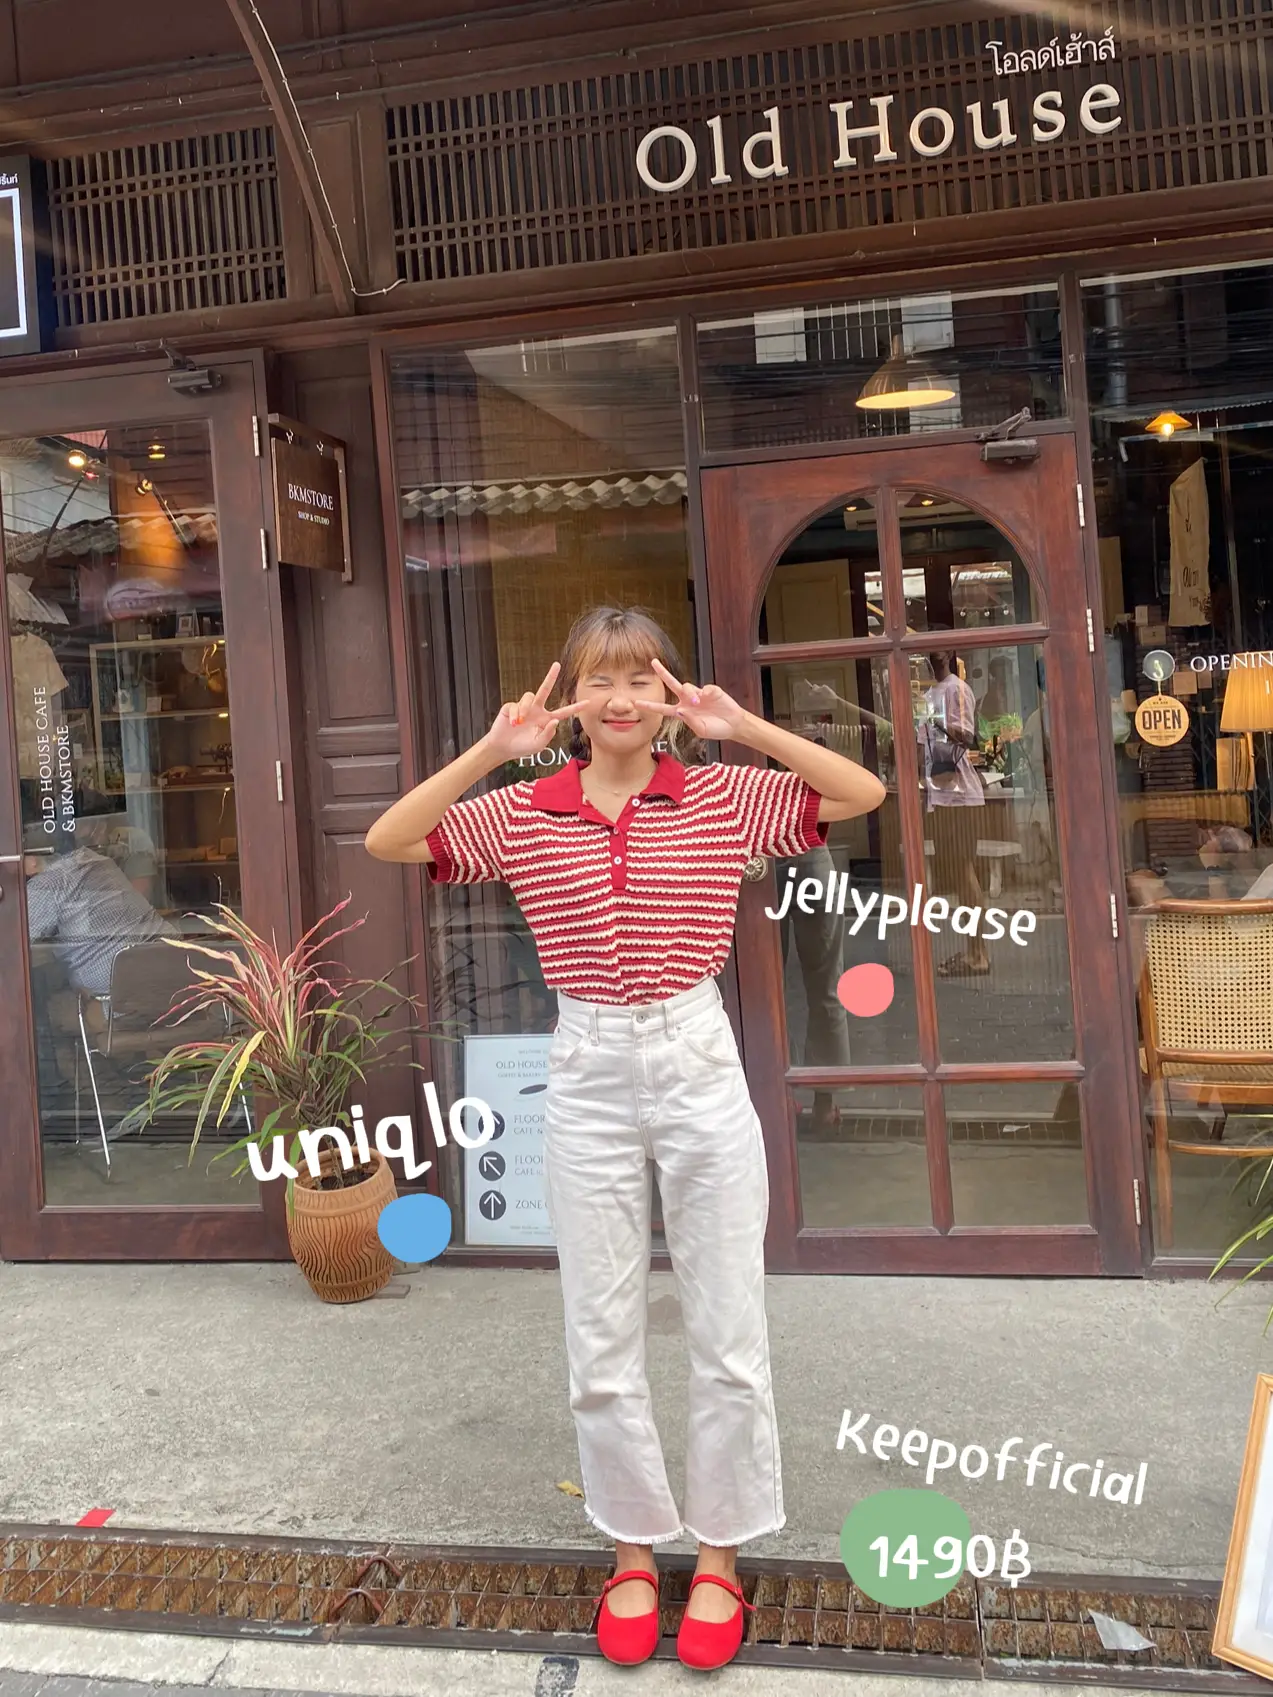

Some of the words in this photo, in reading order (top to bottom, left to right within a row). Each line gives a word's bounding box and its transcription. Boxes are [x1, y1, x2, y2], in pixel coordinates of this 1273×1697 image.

[985, 25, 1116, 76] โอลด์เฮ้าส์
[636, 107, 789, 192] Old
[829, 81, 1122, 169] House
[288, 483, 333, 510] BKMSTORE
[298, 511, 309, 520] SHOP
[314, 515, 330, 525] STUDIO
[34, 686, 47, 730] CAFE
[1142, 709, 1182, 731] OPEN
[38, 734, 52, 792] HOUSE
[56, 725, 74, 815] BKMSTORE
[42, 797, 55, 833] OLD
[62, 820, 76, 832] &
[495, 1060, 516, 1070] OLD
[517, 1060, 548, 1070] HOUSE
[515, 1199, 543, 1209] ZONE
